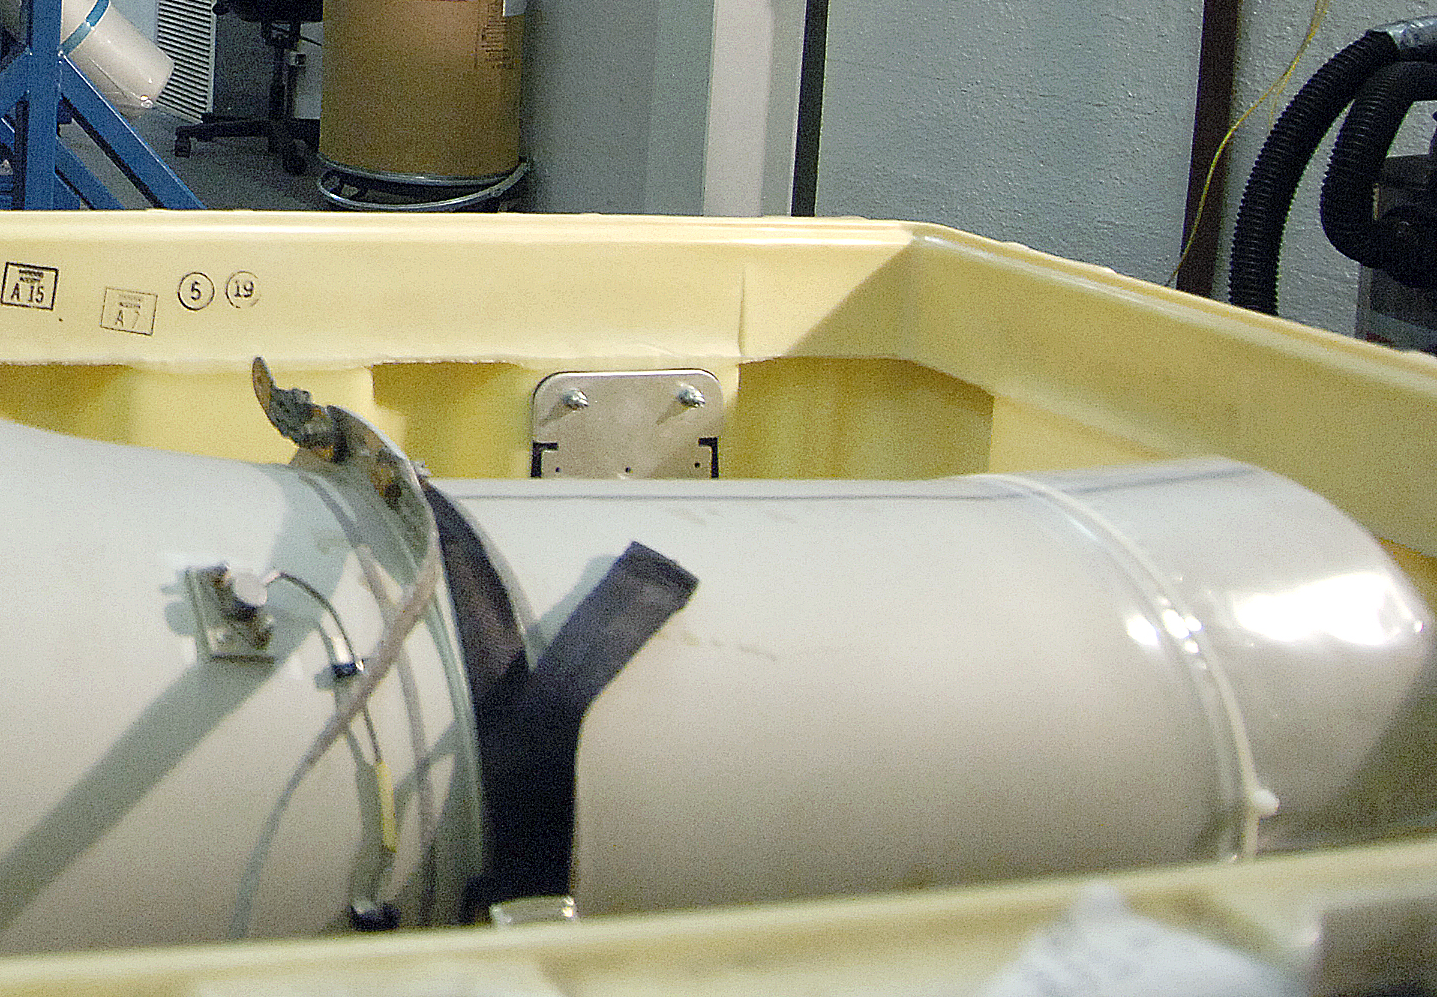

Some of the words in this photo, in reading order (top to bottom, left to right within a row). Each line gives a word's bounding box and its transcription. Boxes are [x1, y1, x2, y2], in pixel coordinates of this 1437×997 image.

[10, 282, 21, 301] A
[28, 285, 45, 303] 15
[190, 280, 202, 302] 5
[233, 279, 255, 299] 19
[114, 308, 125, 327] A
